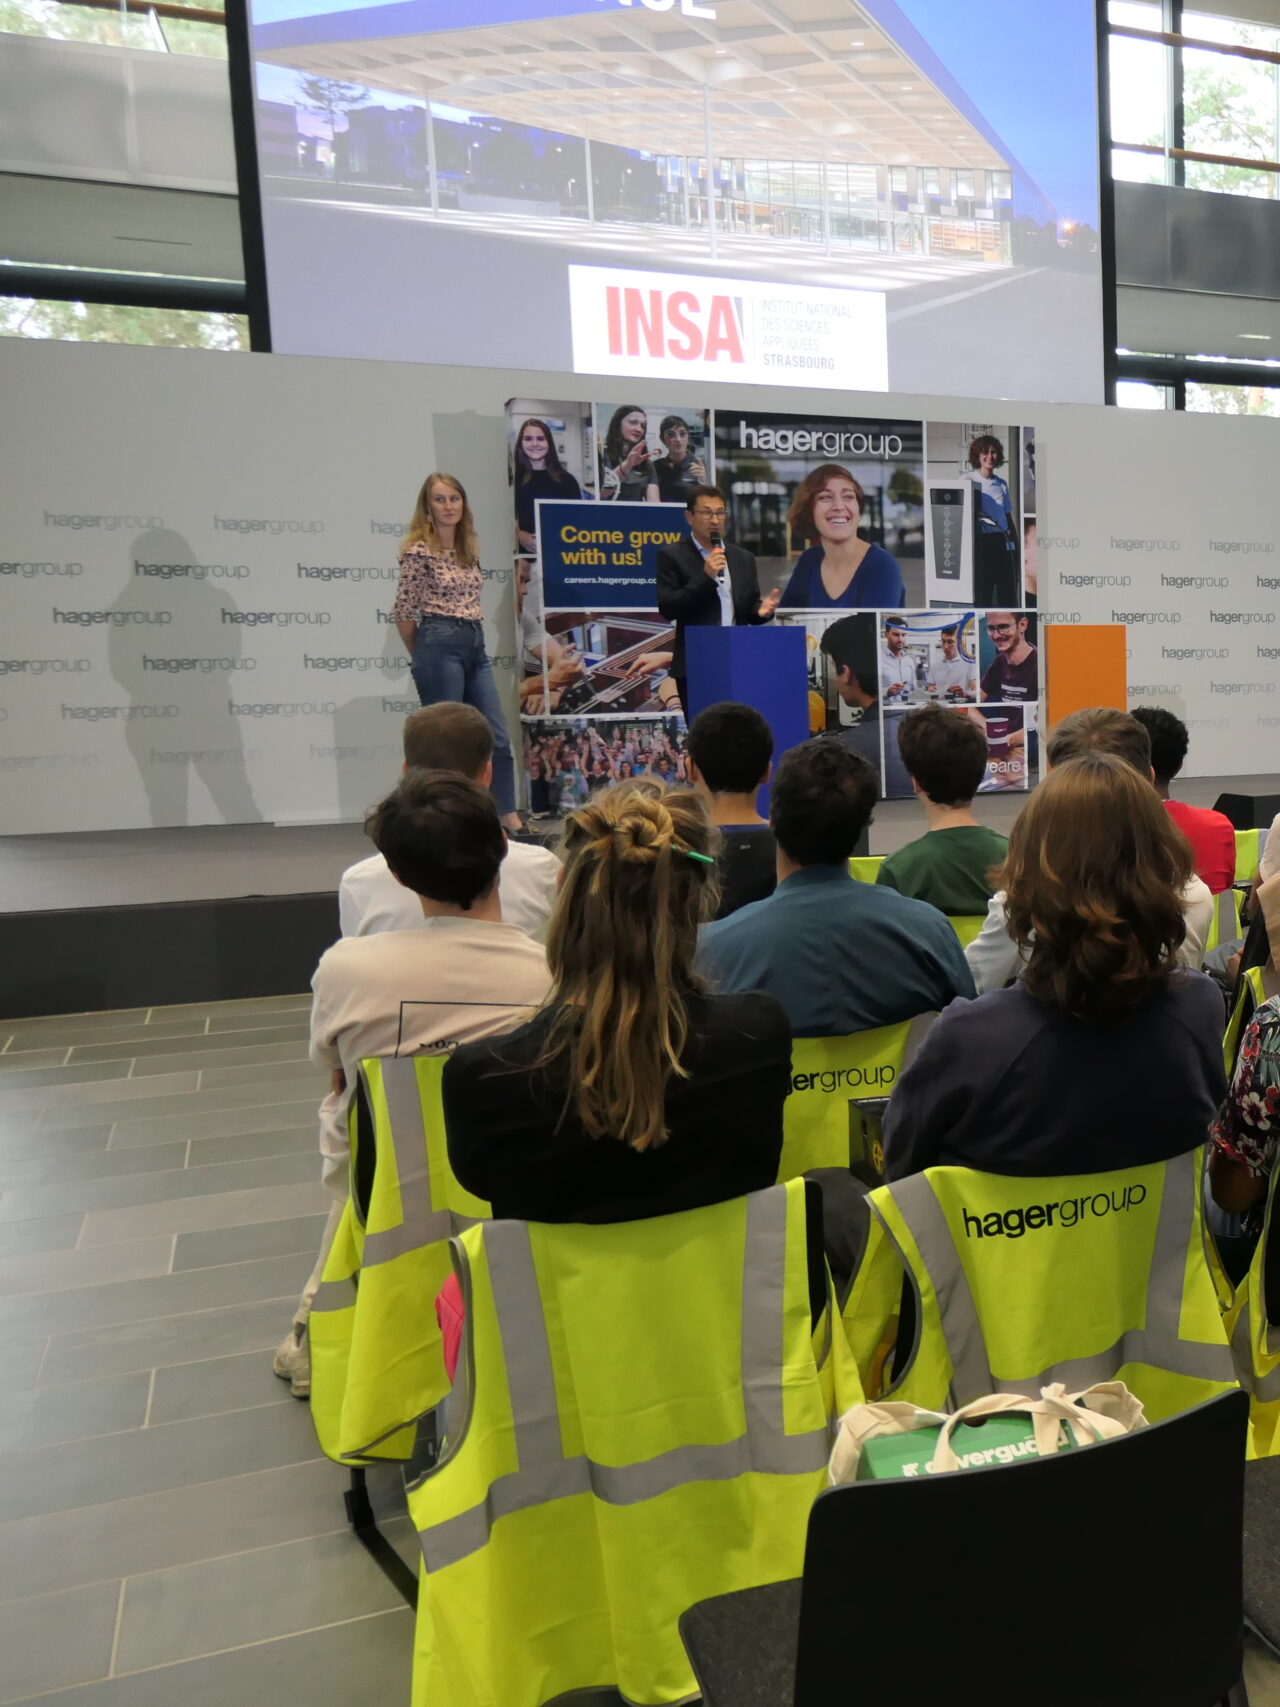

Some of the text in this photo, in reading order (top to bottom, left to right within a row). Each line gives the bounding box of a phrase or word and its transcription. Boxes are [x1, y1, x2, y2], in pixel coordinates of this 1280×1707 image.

[606, 286, 744, 364] INSA
[763, 353, 835, 370] STRASBOURG
[739, 421, 902, 460] hagergroup
[44, 510, 163, 531] hagergroup
[214, 514, 325, 535] hagergroup
[561, 526, 681, 548] Come grow
[1037, 537, 1080, 550] rgroup
[1110, 536, 1181, 552] hagergroup
[1209, 538, 1275, 554] hagergroup
[562, 548, 642, 566] with us!
[0, 562, 83, 579] ergroup
[133, 560, 250, 580] hagergroup
[564, 576, 657, 586] careers.hagergroup.co
[1059, 572, 1131, 588] hagergroup
[1160, 573, 1229, 589] hagergroup
[53, 607, 172, 627] hagergroup
[221, 607, 331, 628] hagergroup
[1111, 609, 1181, 625] hagergroup
[1210, 610, 1275, 625] hagergroup
[1161, 645, 1229, 661] hagergroup
[0, 658, 92, 676] gergroup
[142, 655, 257, 674] hagergroup
[303, 653, 409, 672] hagergroup
[1127, 683, 1182, 697] gergroup
[1210, 681, 1276, 696] hagergroup
[61, 703, 180, 722] hagergroup
[228, 700, 337, 719] hagergroup
[986, 760, 1021, 773] eare
[787, 1065, 896, 1096] ergroup
[963, 1184, 1147, 1240] hagergroup
